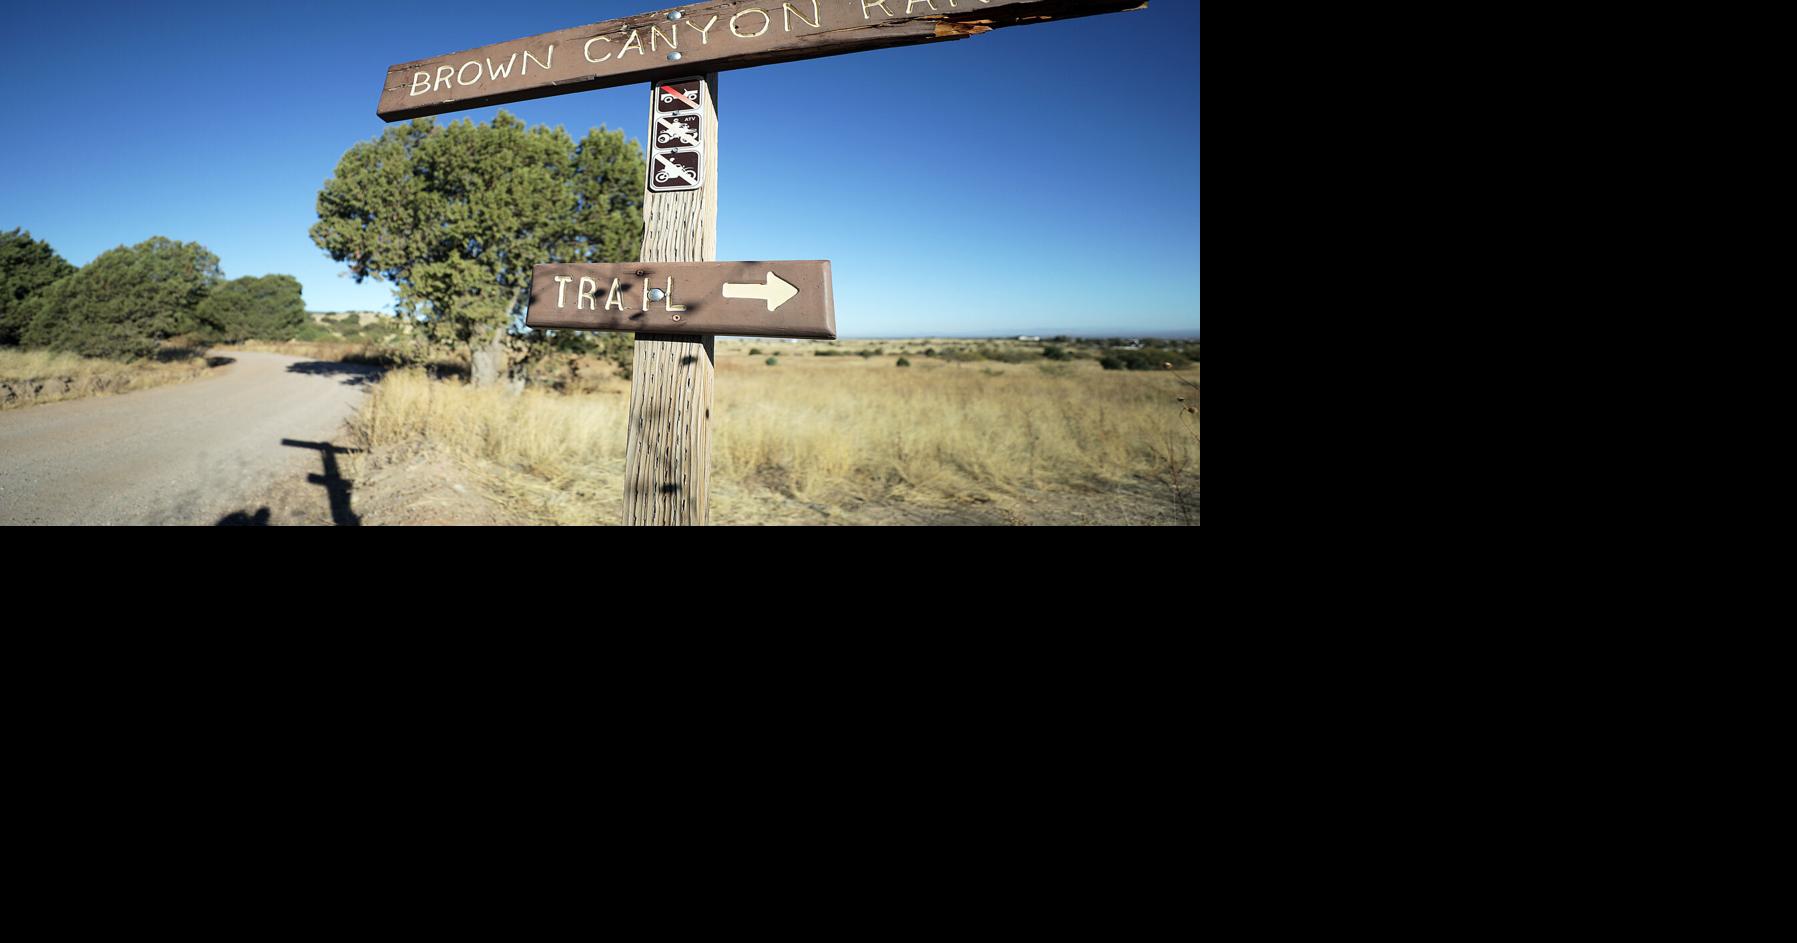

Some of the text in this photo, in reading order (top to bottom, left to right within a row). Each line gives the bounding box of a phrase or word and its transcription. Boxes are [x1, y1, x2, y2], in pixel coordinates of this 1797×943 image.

[409, 45, 554, 97] BROWN
[583, 0, 821, 63] CANYON
[554, 275, 687, 311] TRAIL
